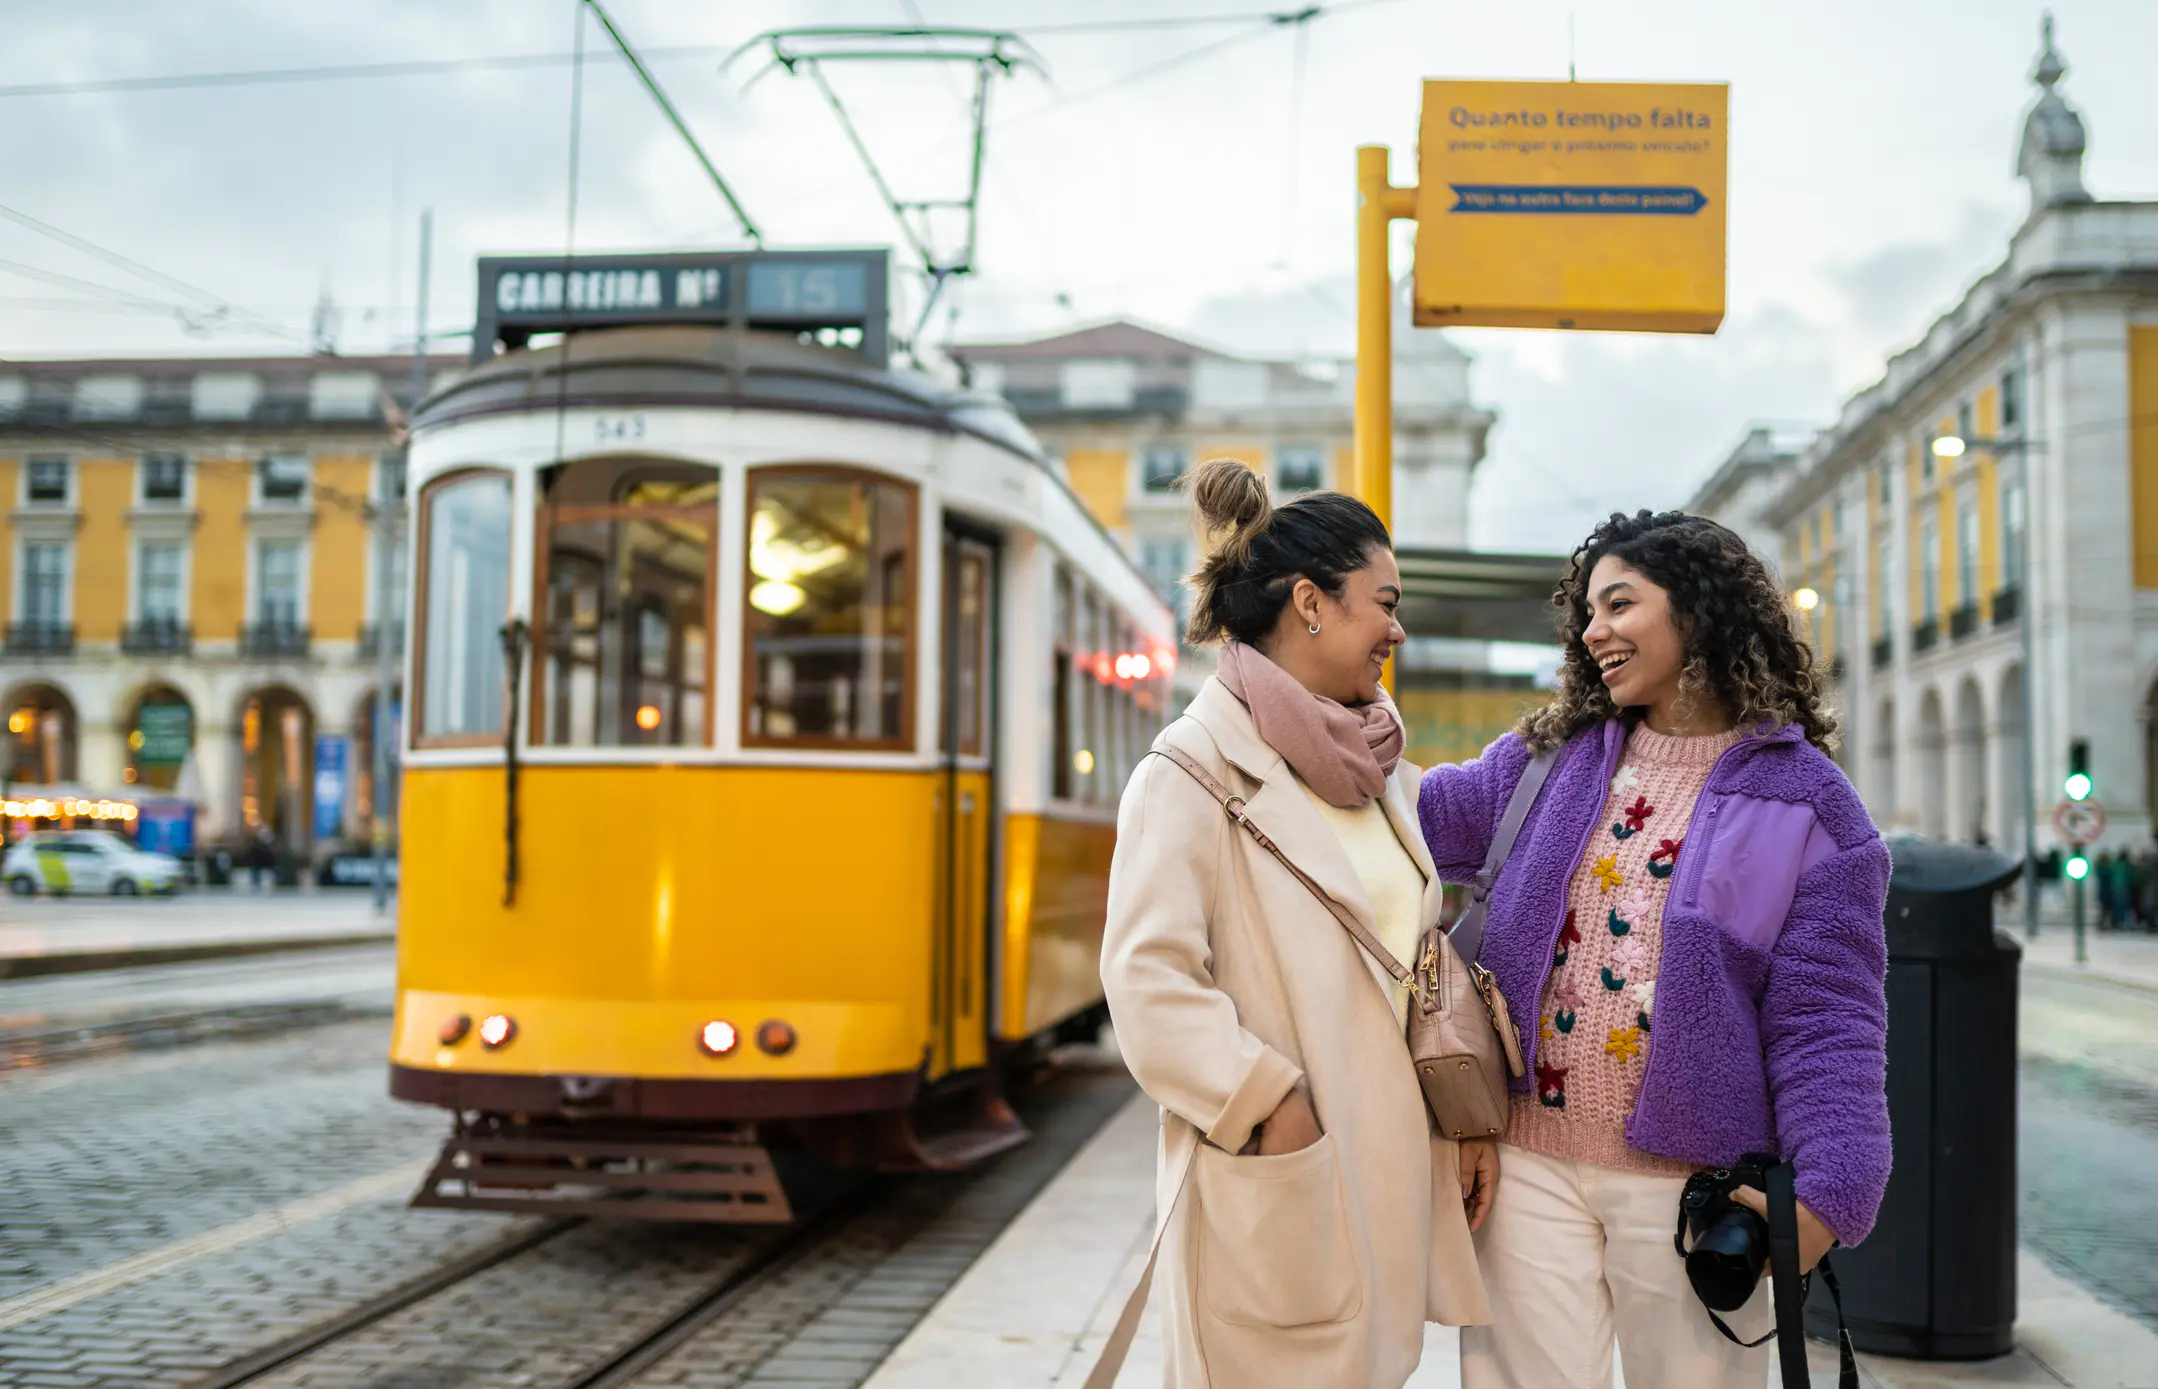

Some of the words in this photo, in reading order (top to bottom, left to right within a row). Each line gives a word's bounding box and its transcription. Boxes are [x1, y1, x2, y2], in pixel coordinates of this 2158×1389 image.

[1449, 106, 1548, 129] Quanto
[1556, 108, 1641, 131] tempo
[1650, 108, 1711, 129] falta
[497, 269, 661, 312] CARREIRA
[779, 268, 836, 312] 15
